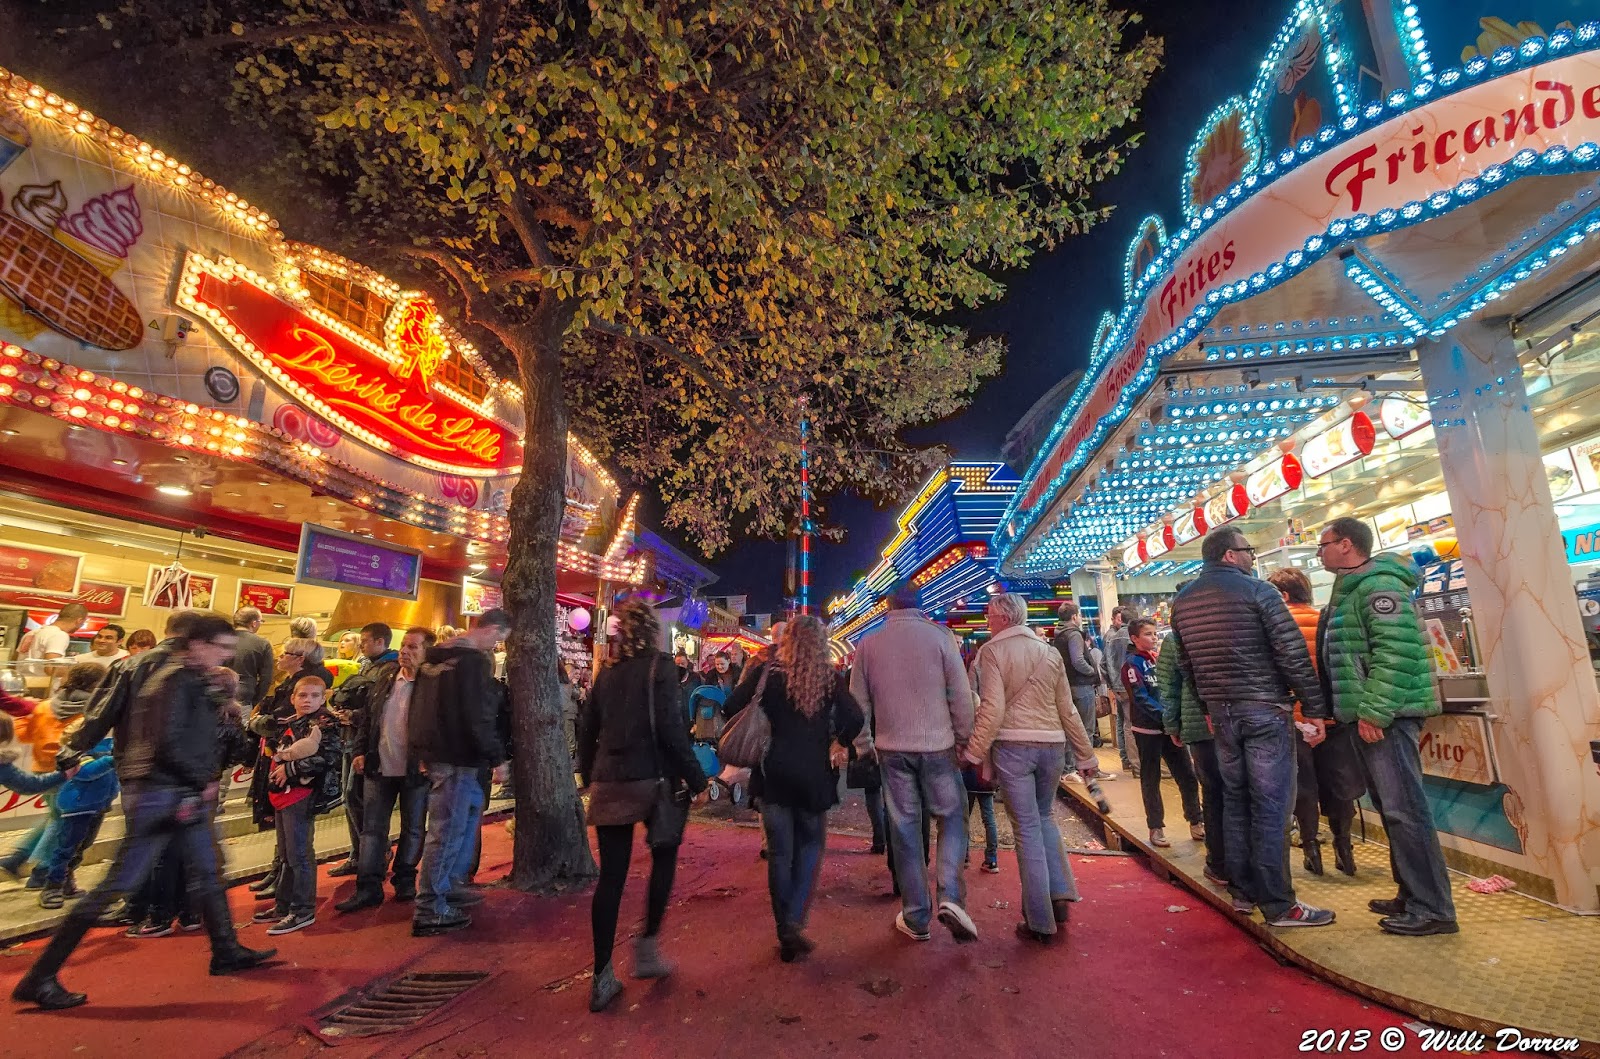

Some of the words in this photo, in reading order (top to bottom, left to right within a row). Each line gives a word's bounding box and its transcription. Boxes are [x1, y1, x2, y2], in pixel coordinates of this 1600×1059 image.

[1325, 80, 1600, 212] Fricande
[1160, 239, 1237, 327] Frites
[271, 328, 406, 412] Désiré
[400, 401, 437, 431] de
[433, 417, 501, 463] Lille
[78, 588, 114, 605] Lille
